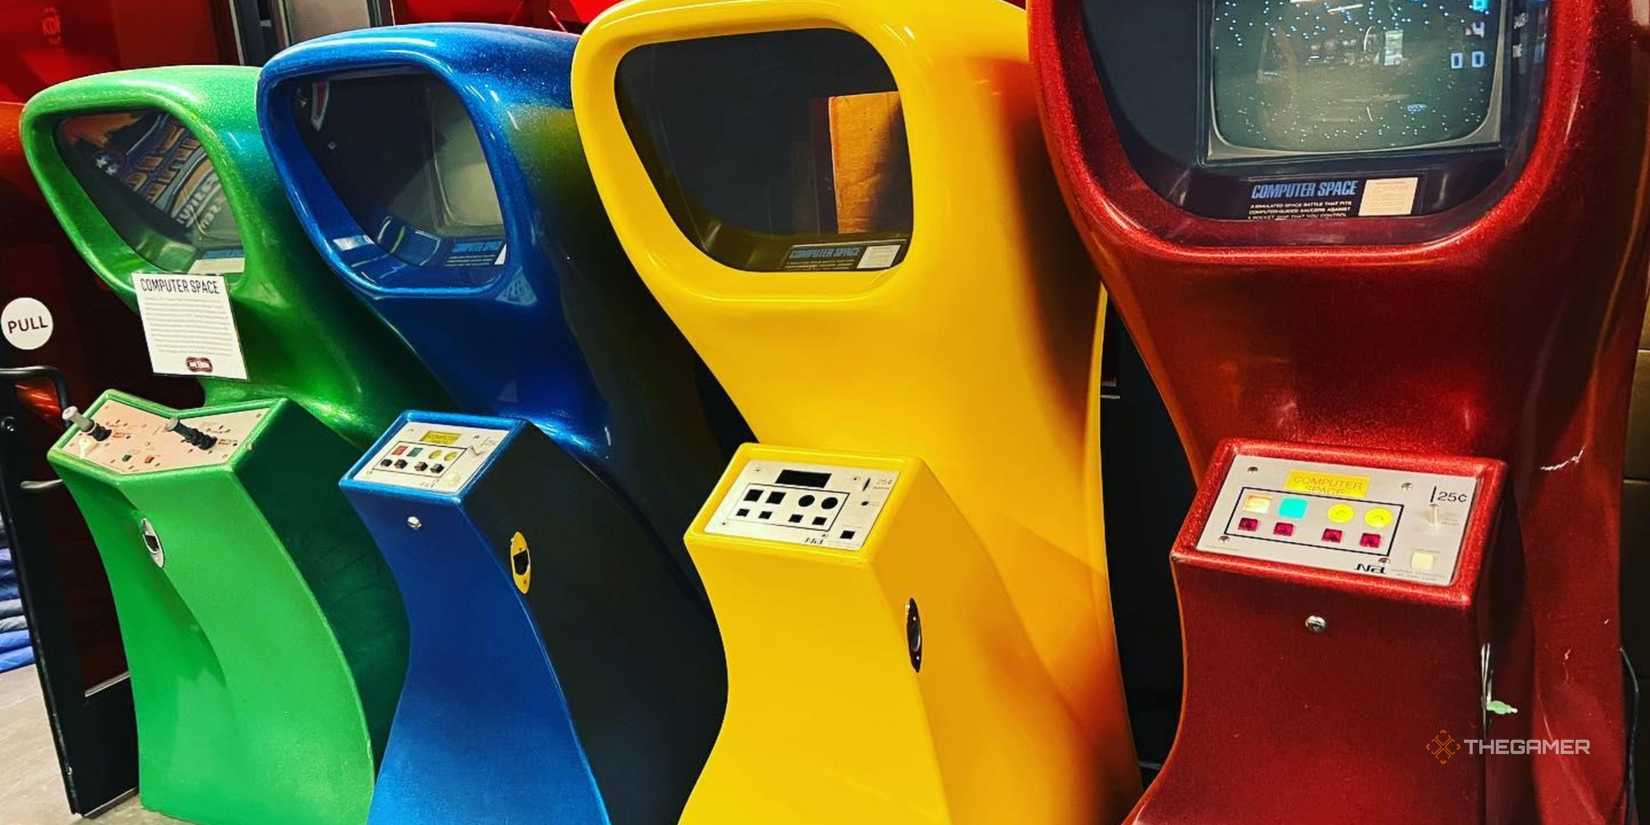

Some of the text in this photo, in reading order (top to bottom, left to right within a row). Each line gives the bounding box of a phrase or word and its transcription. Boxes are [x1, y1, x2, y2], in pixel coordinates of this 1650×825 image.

[1251, 181, 1314, 200] COMPUTER
[1318, 180, 1359, 197] SPACE
[139, 277, 220, 295] COMPUTER SPACE
[7, 316, 49, 334] PULL
[1293, 475, 1363, 490] COMPUTER
